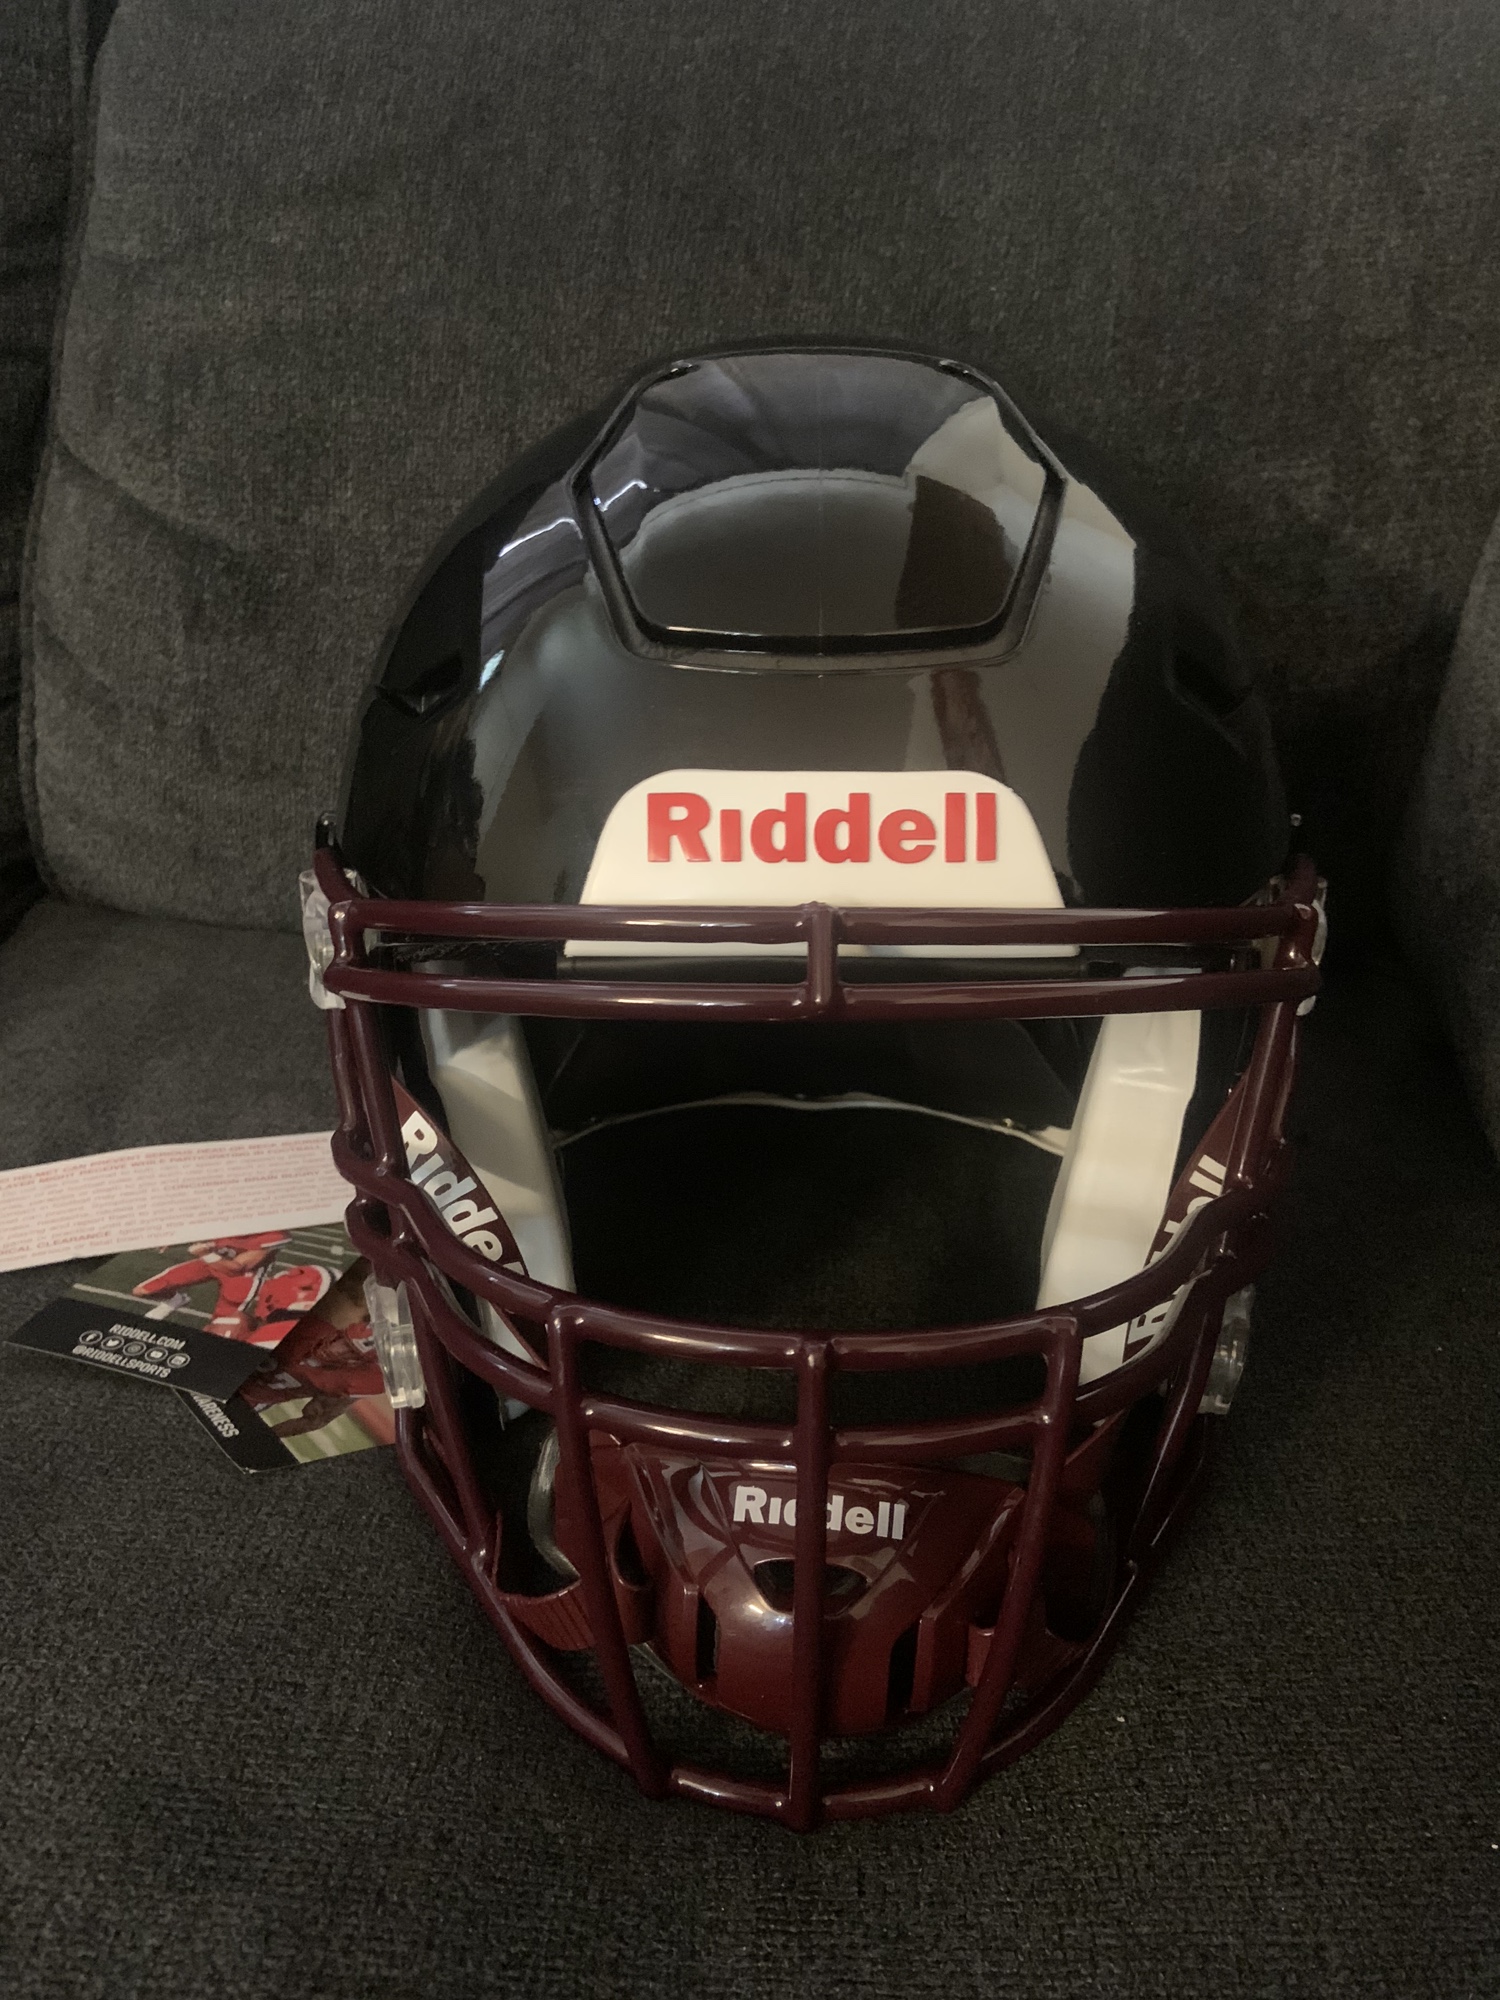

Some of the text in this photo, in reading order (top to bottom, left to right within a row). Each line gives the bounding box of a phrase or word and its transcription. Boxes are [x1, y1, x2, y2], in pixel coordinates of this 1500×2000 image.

[647, 792, 997, 864] Riddell
[402, 1110, 525, 1275] Ridde
[72, 1344, 171, 1378] @RIDDELLSPORTS
[108, 1323, 186, 1351] RIDDELL.COM
